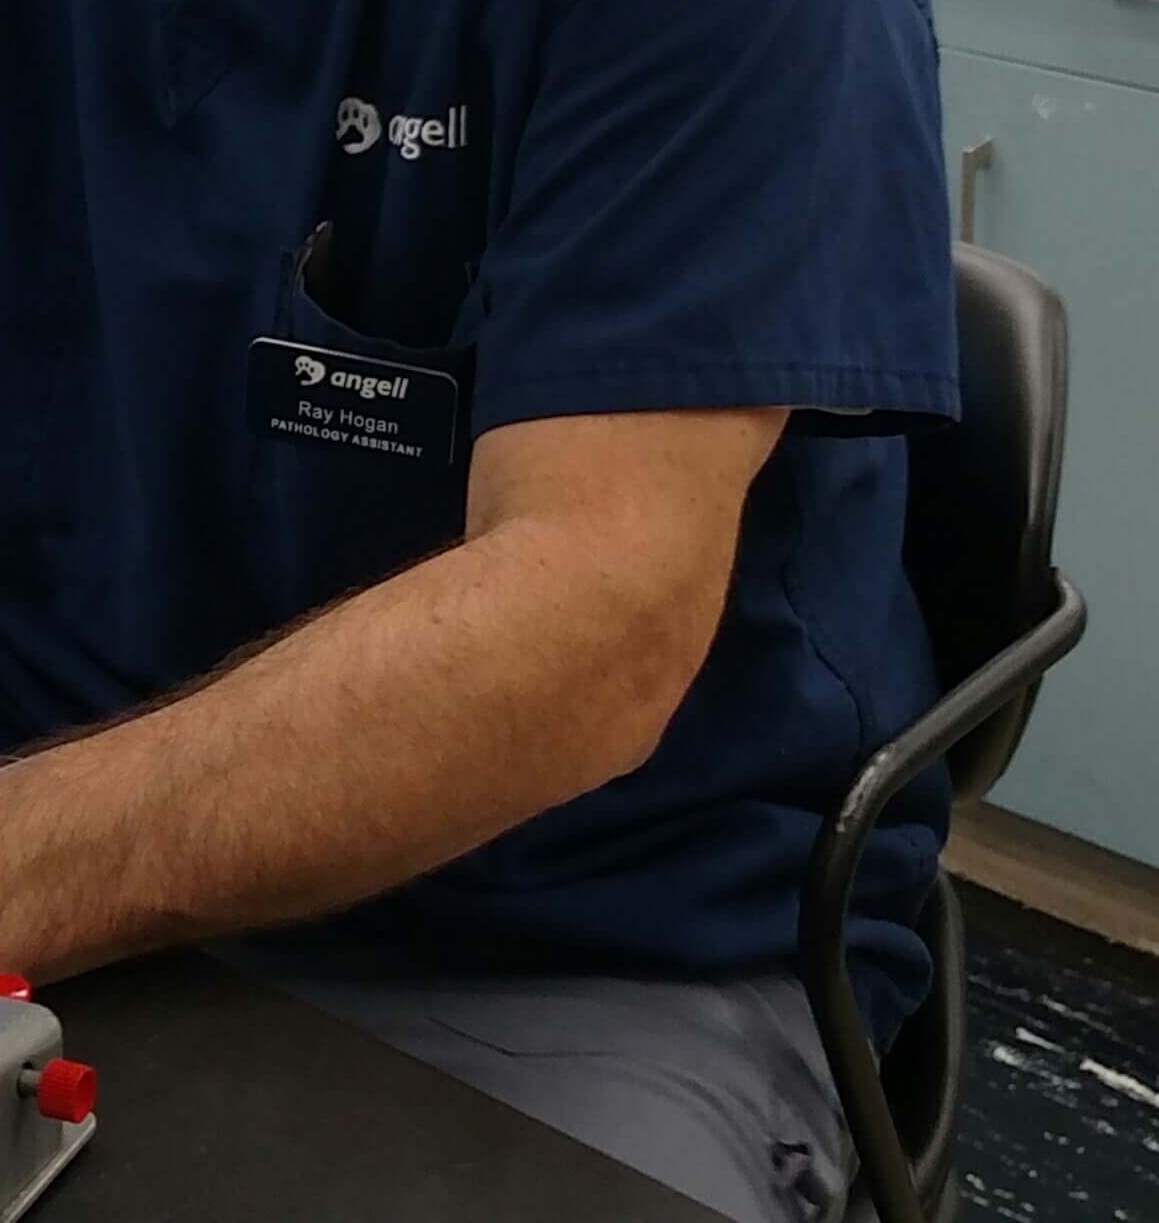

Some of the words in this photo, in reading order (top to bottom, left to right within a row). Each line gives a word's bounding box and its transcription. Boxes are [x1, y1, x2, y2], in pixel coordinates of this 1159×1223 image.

[388, 105, 467, 159] agell
[330, 371, 409, 399] angell
[298, 400, 334, 424] Ray
[340, 409, 399, 434] Hogan
[271, 418, 349, 443] PATHOLOGY
[351, 434, 423, 458] ASSISTANT
